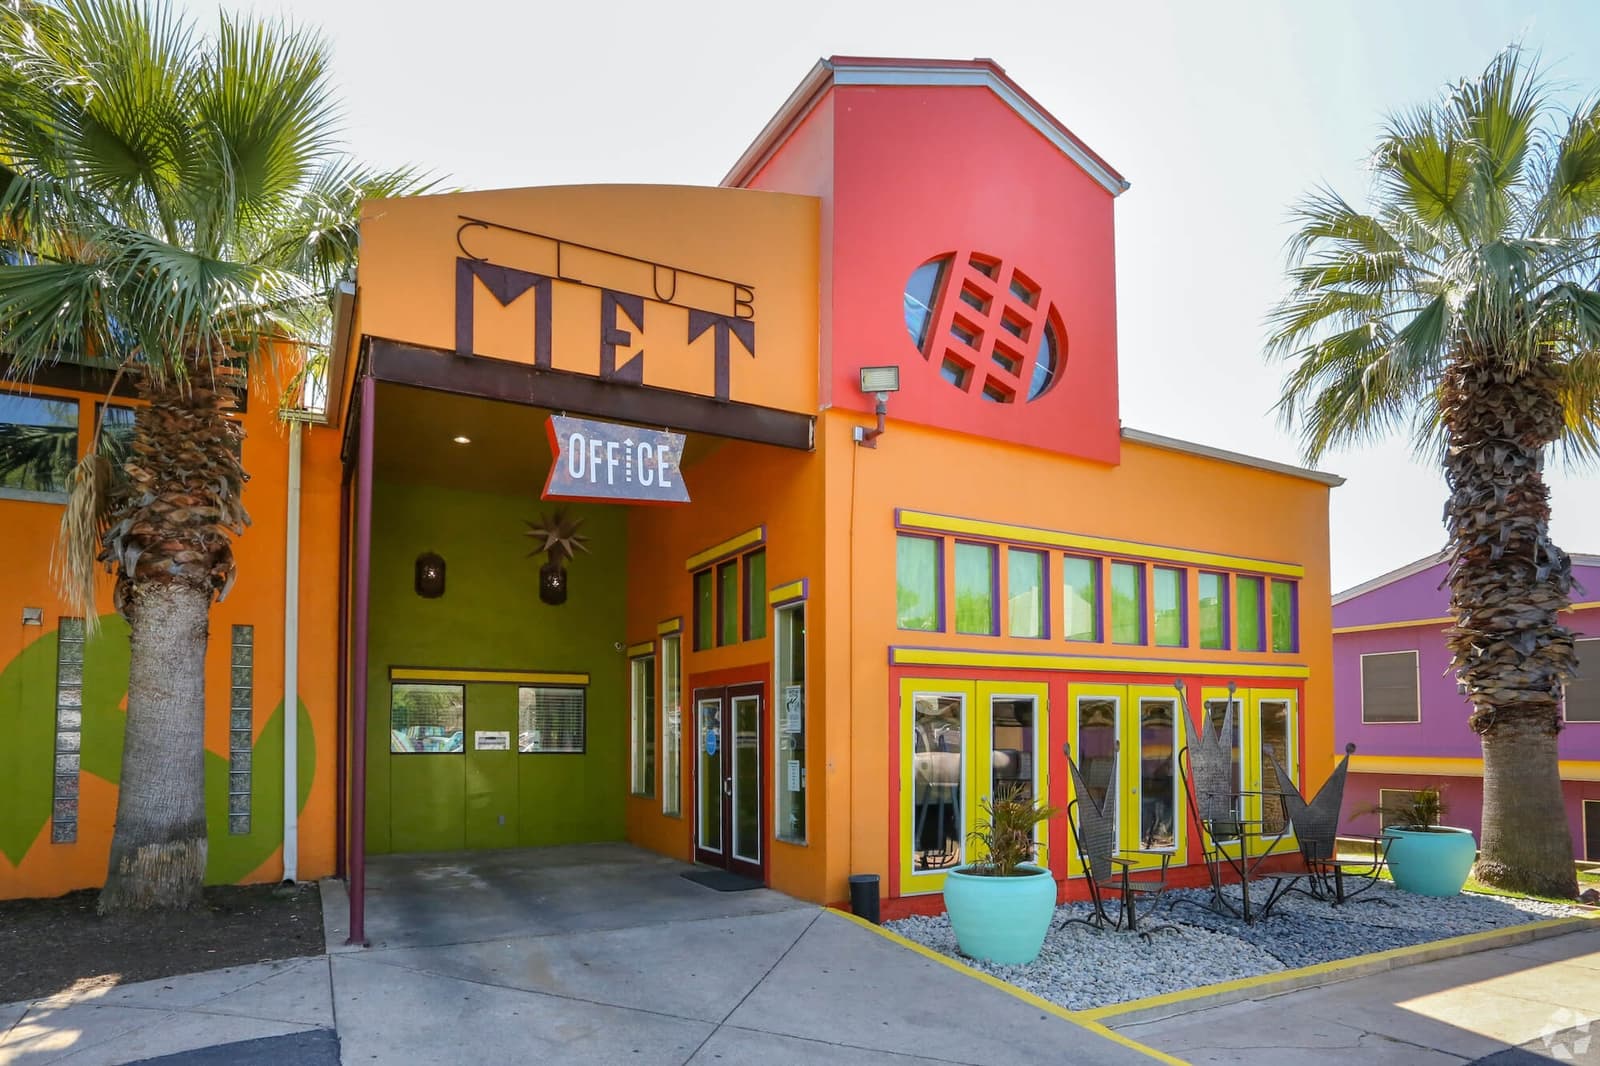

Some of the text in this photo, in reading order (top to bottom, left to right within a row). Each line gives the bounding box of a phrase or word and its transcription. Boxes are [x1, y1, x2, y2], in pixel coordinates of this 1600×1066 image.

[456, 217, 754, 318] CLUB
[455, 257, 755, 400] MET
[568, 432, 672, 487] OFFICE
